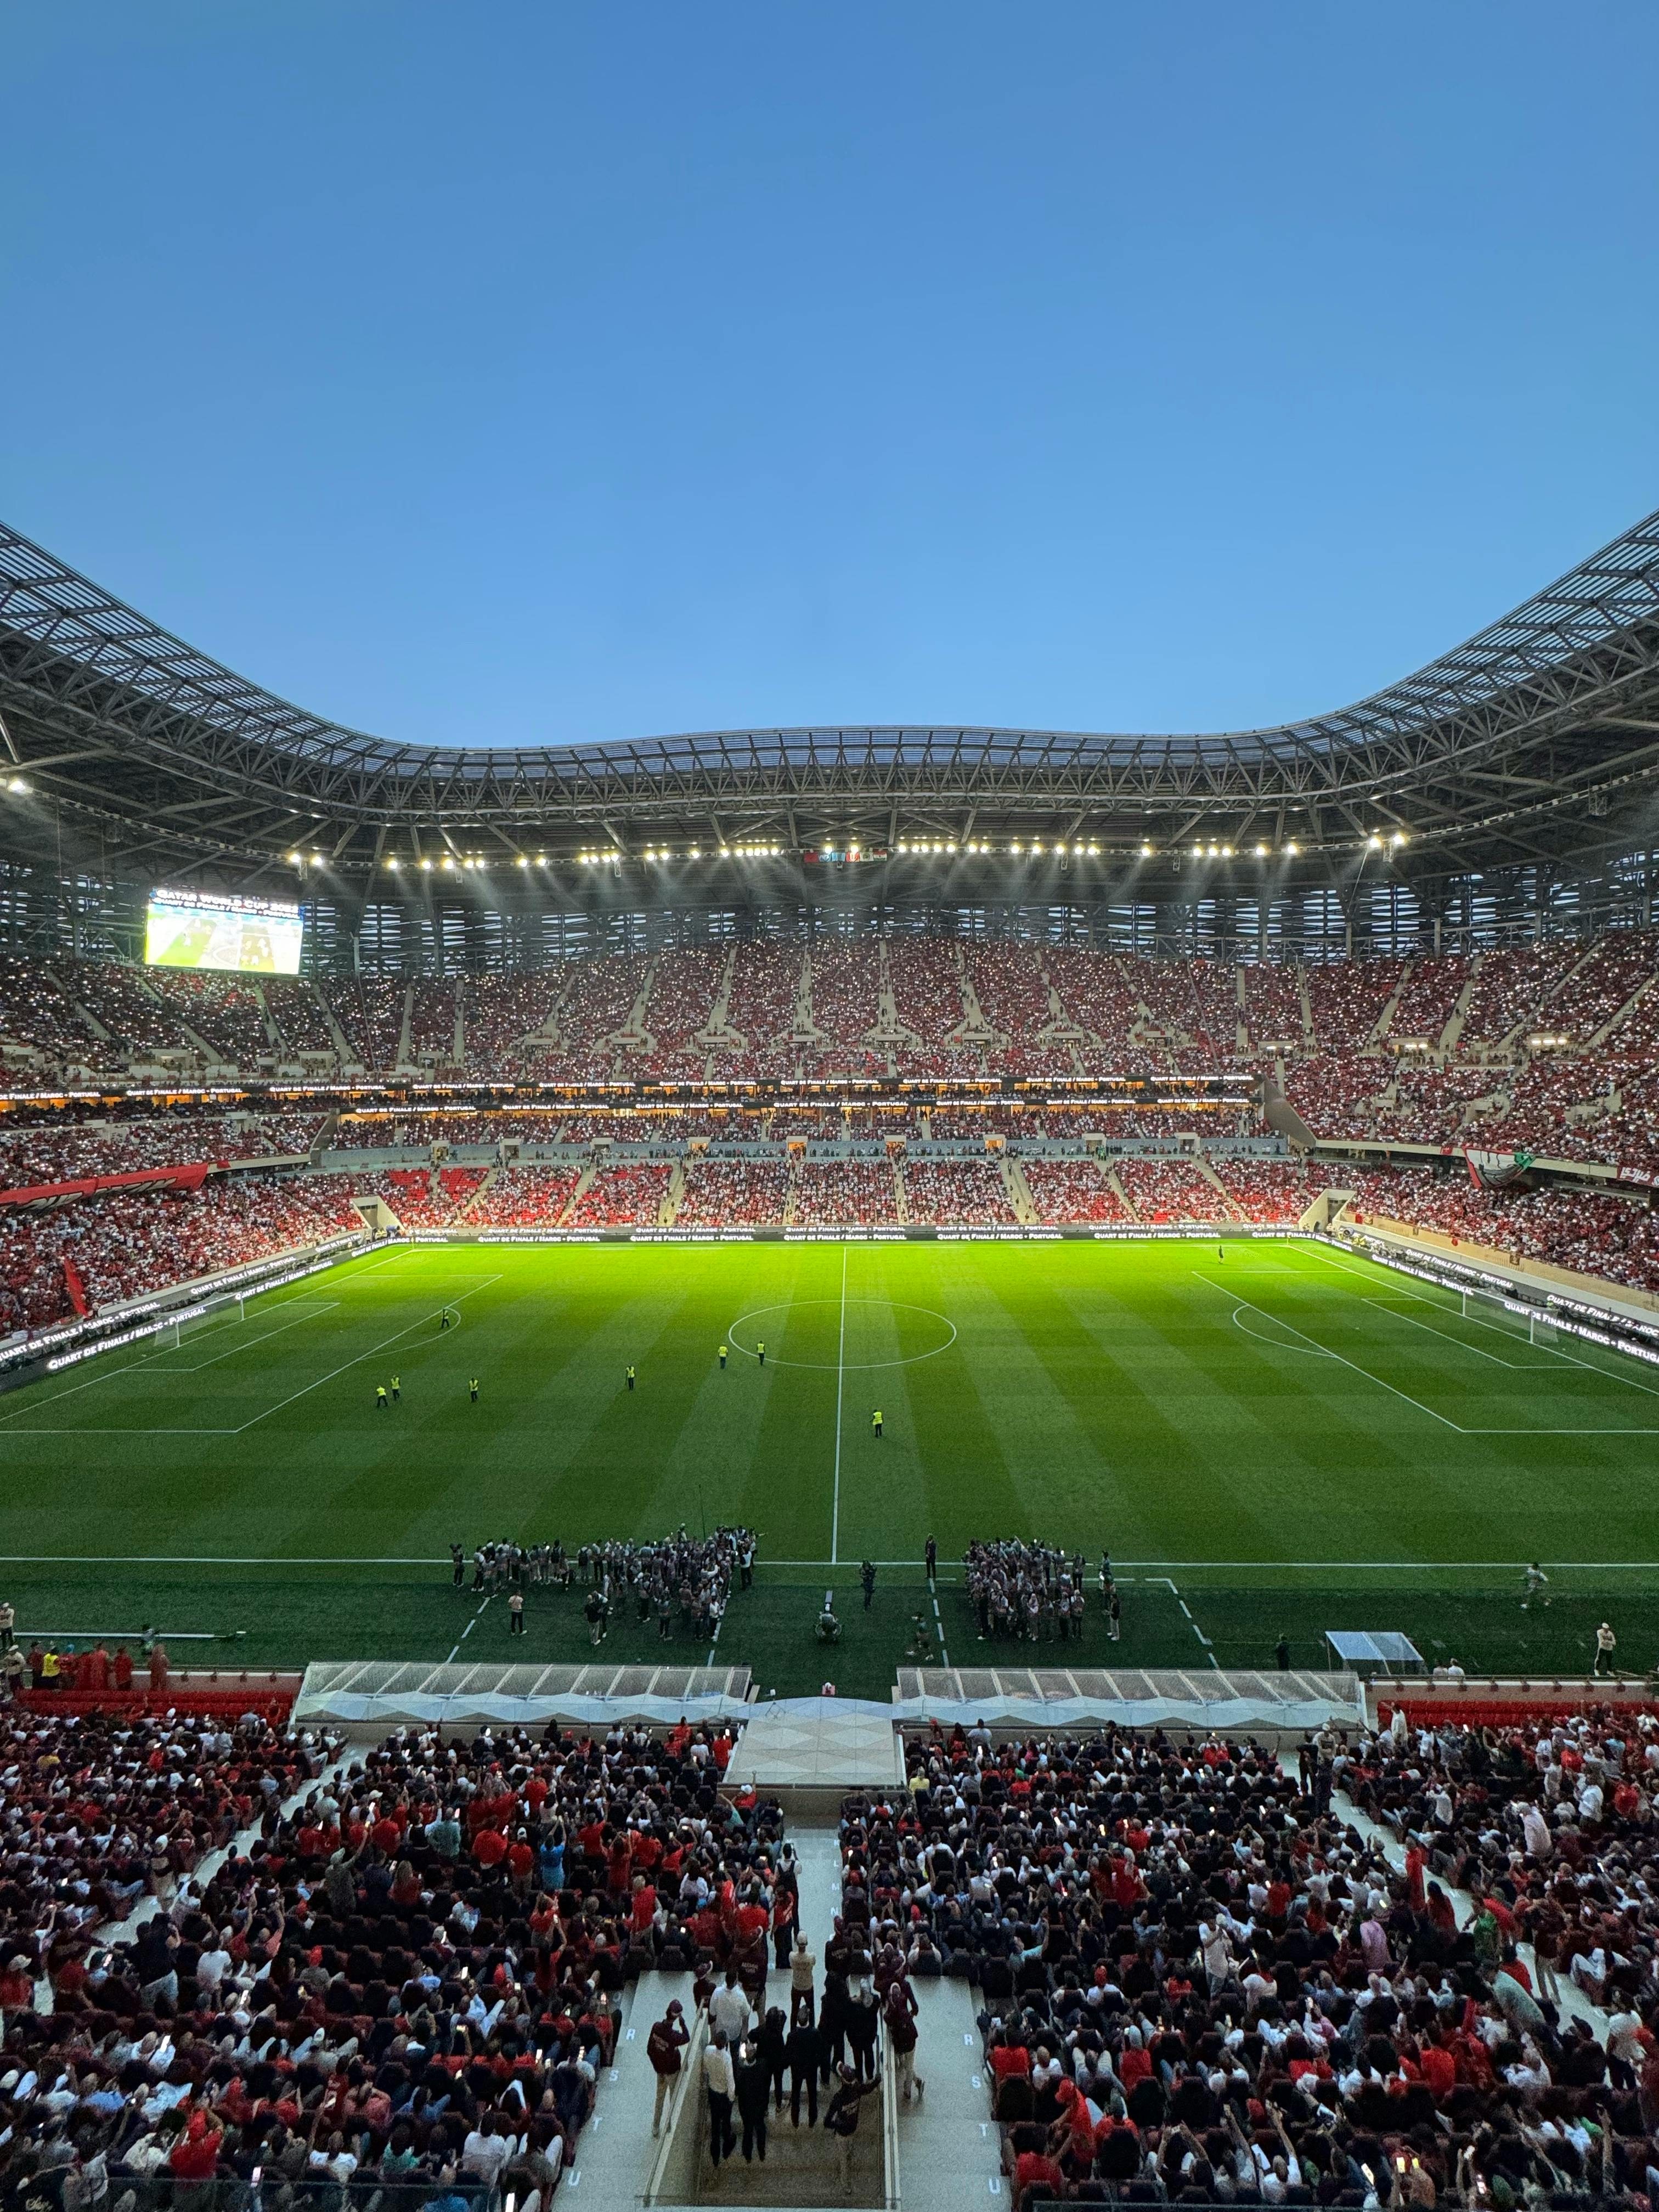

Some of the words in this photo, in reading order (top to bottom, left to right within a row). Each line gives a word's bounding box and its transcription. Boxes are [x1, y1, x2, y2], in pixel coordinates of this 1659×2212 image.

[156, 890, 198, 901] QATAR
[244, 900, 268, 910] CUP
[1406, 1249, 1425, 1259] QUART
[1432, 1256, 1452, 1268] FINALE
[1455, 1264, 1476, 1276] MAROC
[1480, 1272, 1513, 1288] PORTUGAL
[1504, 1301, 1531, 1316] QUART
[1543, 1314, 1572, 1331] FINALE
[1578, 1326, 1610, 1345] MAROC
[0, 1345, 27, 1361] UART
[43, 1328, 78, 1344] FINALE
[48, 1351, 83, 1370] QUART
[98, 1334, 129, 1352] FINALE
[626, 2029, 635, 2040] R
[964, 2034, 973, 2046] R
[609, 2070, 619, 2081] S
[972, 2076, 981, 2089] S
[592, 2117, 602, 2131] T
[979, 2124, 988, 2136] T
[568, 2171, 581, 2186] U
[989, 2177, 1000, 2194] U
